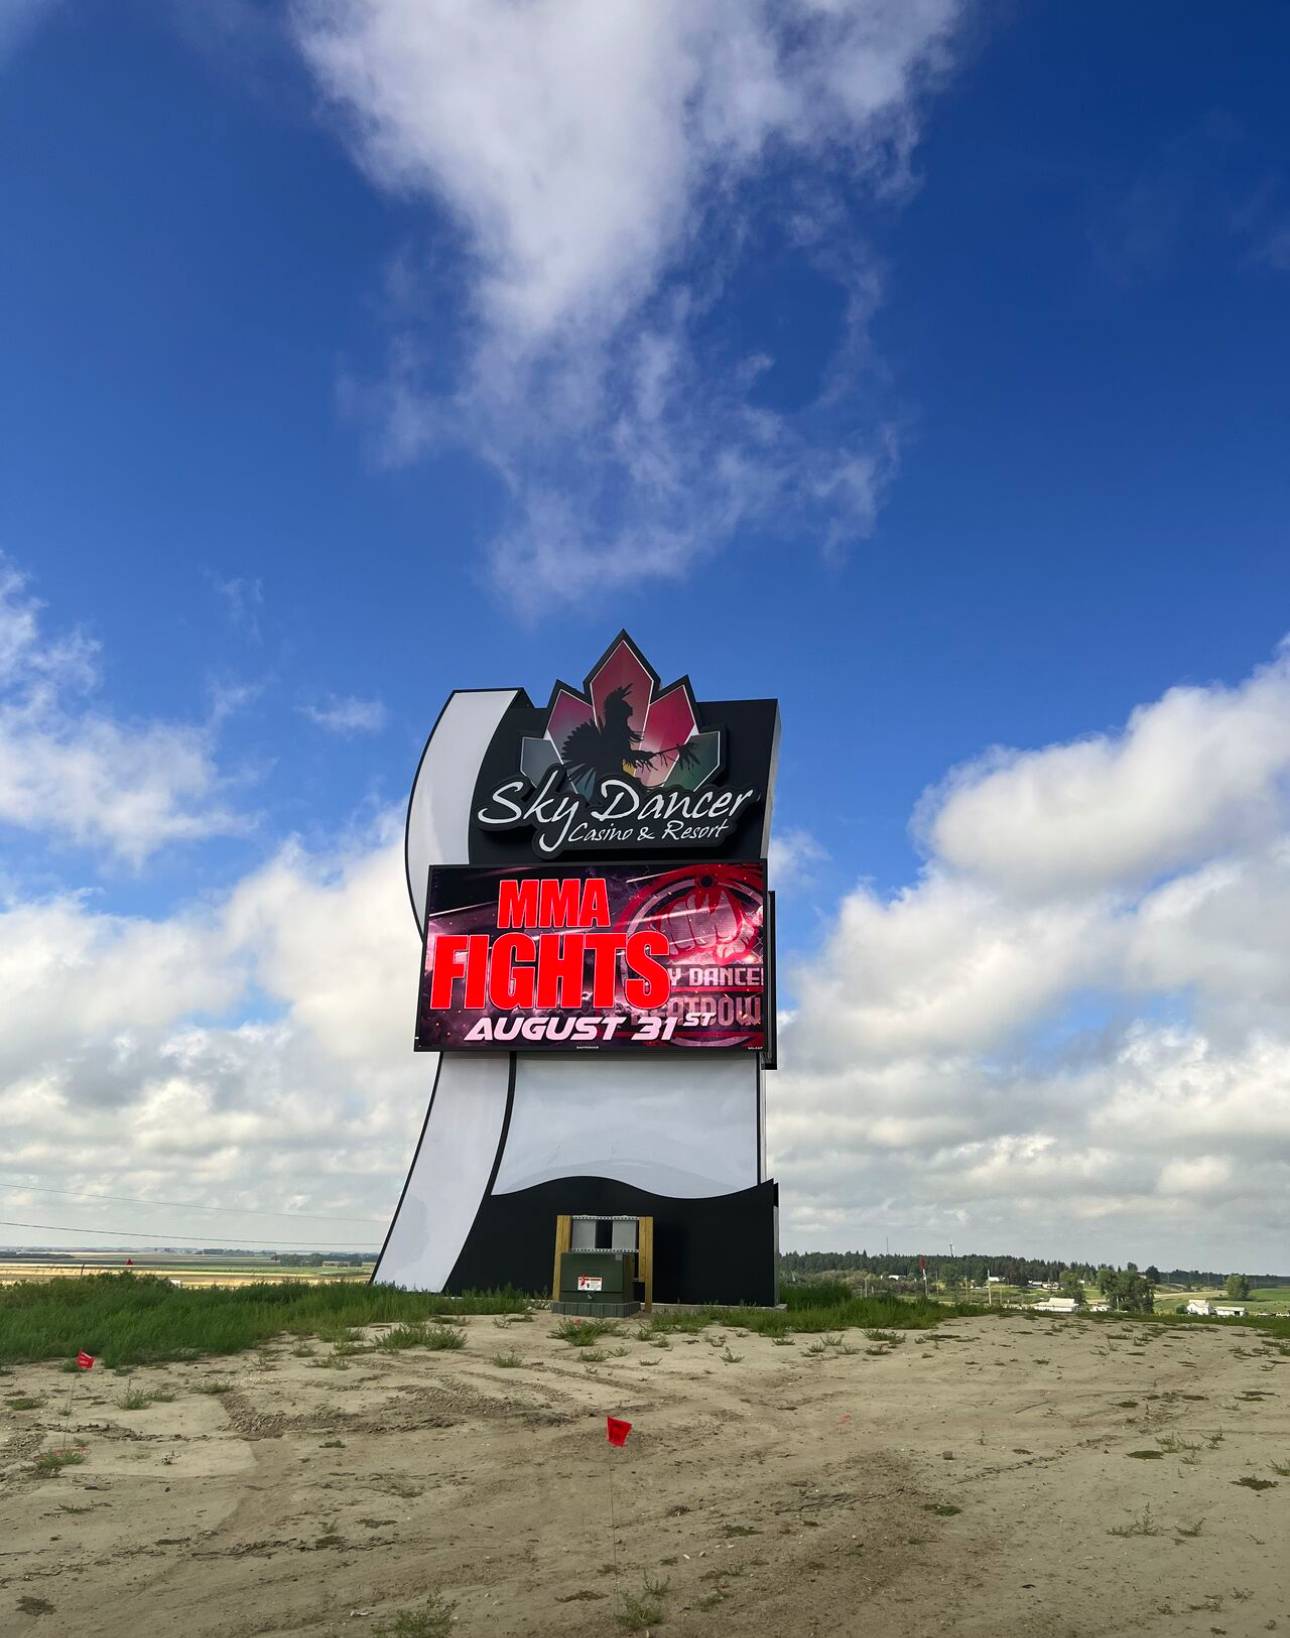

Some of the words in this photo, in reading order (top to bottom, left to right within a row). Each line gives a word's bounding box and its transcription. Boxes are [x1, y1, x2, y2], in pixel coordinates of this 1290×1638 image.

[477, 770, 582, 853] Sky
[591, 779, 754, 821] Dancer
[568, 822, 633, 843] Casino
[638, 826, 655, 841] &
[661, 818, 731, 841] Resort
[497, 878, 611, 930] MMA
[430, 931, 672, 1011] FIGHTS
[463, 1016, 628, 1042] AUGUST
